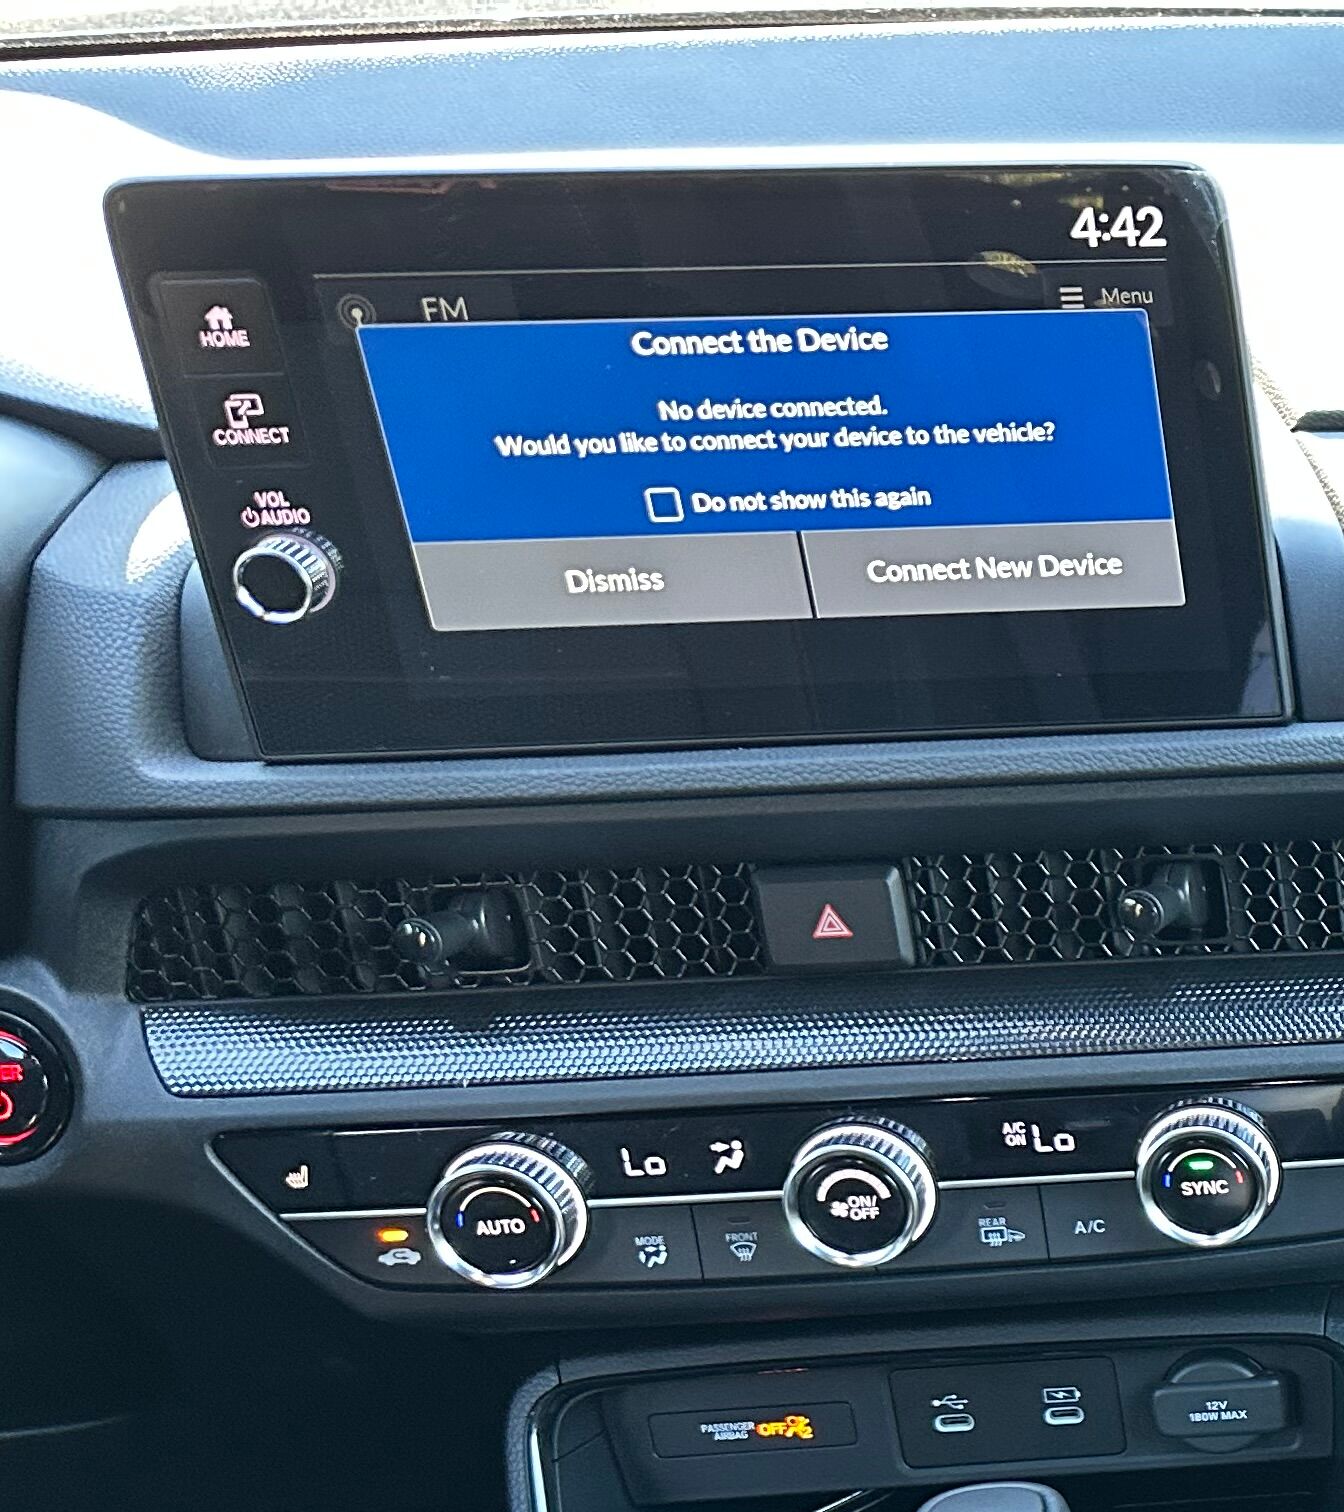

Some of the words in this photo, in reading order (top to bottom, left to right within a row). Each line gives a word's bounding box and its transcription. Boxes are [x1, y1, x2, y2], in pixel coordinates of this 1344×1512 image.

[1070, 204, 1167, 249] 4:42
[1101, 287, 1153, 304] Menu
[422, 297, 469, 321] FM
[199, 330, 250, 348] HOME
[631, 330, 744, 356] Connect
[748, 328, 793, 354] the
[796, 326, 888, 352] Device
[657, 400, 694, 422] No
[696, 398, 766, 420] device
[770, 395, 888, 418] connected.
[213, 427, 290, 445] CONNECT
[494, 434, 570, 457] Would
[574, 436, 616, 458] you
[619, 432, 658, 454] like
[660, 432, 686, 452] to
[690, 430, 778, 451] connect
[780, 431, 829, 452] your
[834, 426, 902, 448] device
[906, 426, 930, 446] to
[933, 424, 970, 444] the
[972, 422, 1055, 444] vehicle?
[254, 491, 290, 509] VOL
[691, 492, 726, 513] Do
[729, 492, 768, 512] not
[770, 490, 827, 510] show
[830, 487, 871, 508] this
[874, 486, 932, 510] again
[259, 509, 310, 527] AUDIO
[866, 559, 972, 583] Connect
[976, 556, 1033, 580] New
[1038, 553, 1123, 579] Device
[564, 568, 665, 594] Dismiss
[1002, 1122, 1026, 1136] A/C
[1005, 1134, 1027, 1147] ON
[1181, 1180, 1229, 1196] SYNC
[847, 1195, 876, 1208] ON/
[850, 1206, 879, 1221] OFF
[978, 1217, 1006, 1227] REAR
[476, 1218, 526, 1236] AUTO
[1074, 1219, 1106, 1235] A/C
[635, 1235, 665, 1246] MODE
[725, 1232, 758, 1243] FRONT
[1206, 1401, 1228, 1410] 12V
[1189, 1412, 1218, 1422] 180W
[1220, 1410, 1248, 1420] MAX
[701, 1421, 755, 1433] PASSENGER
[756, 1422, 787, 1436] OFF
[714, 1431, 748, 1440] AIRBAG
